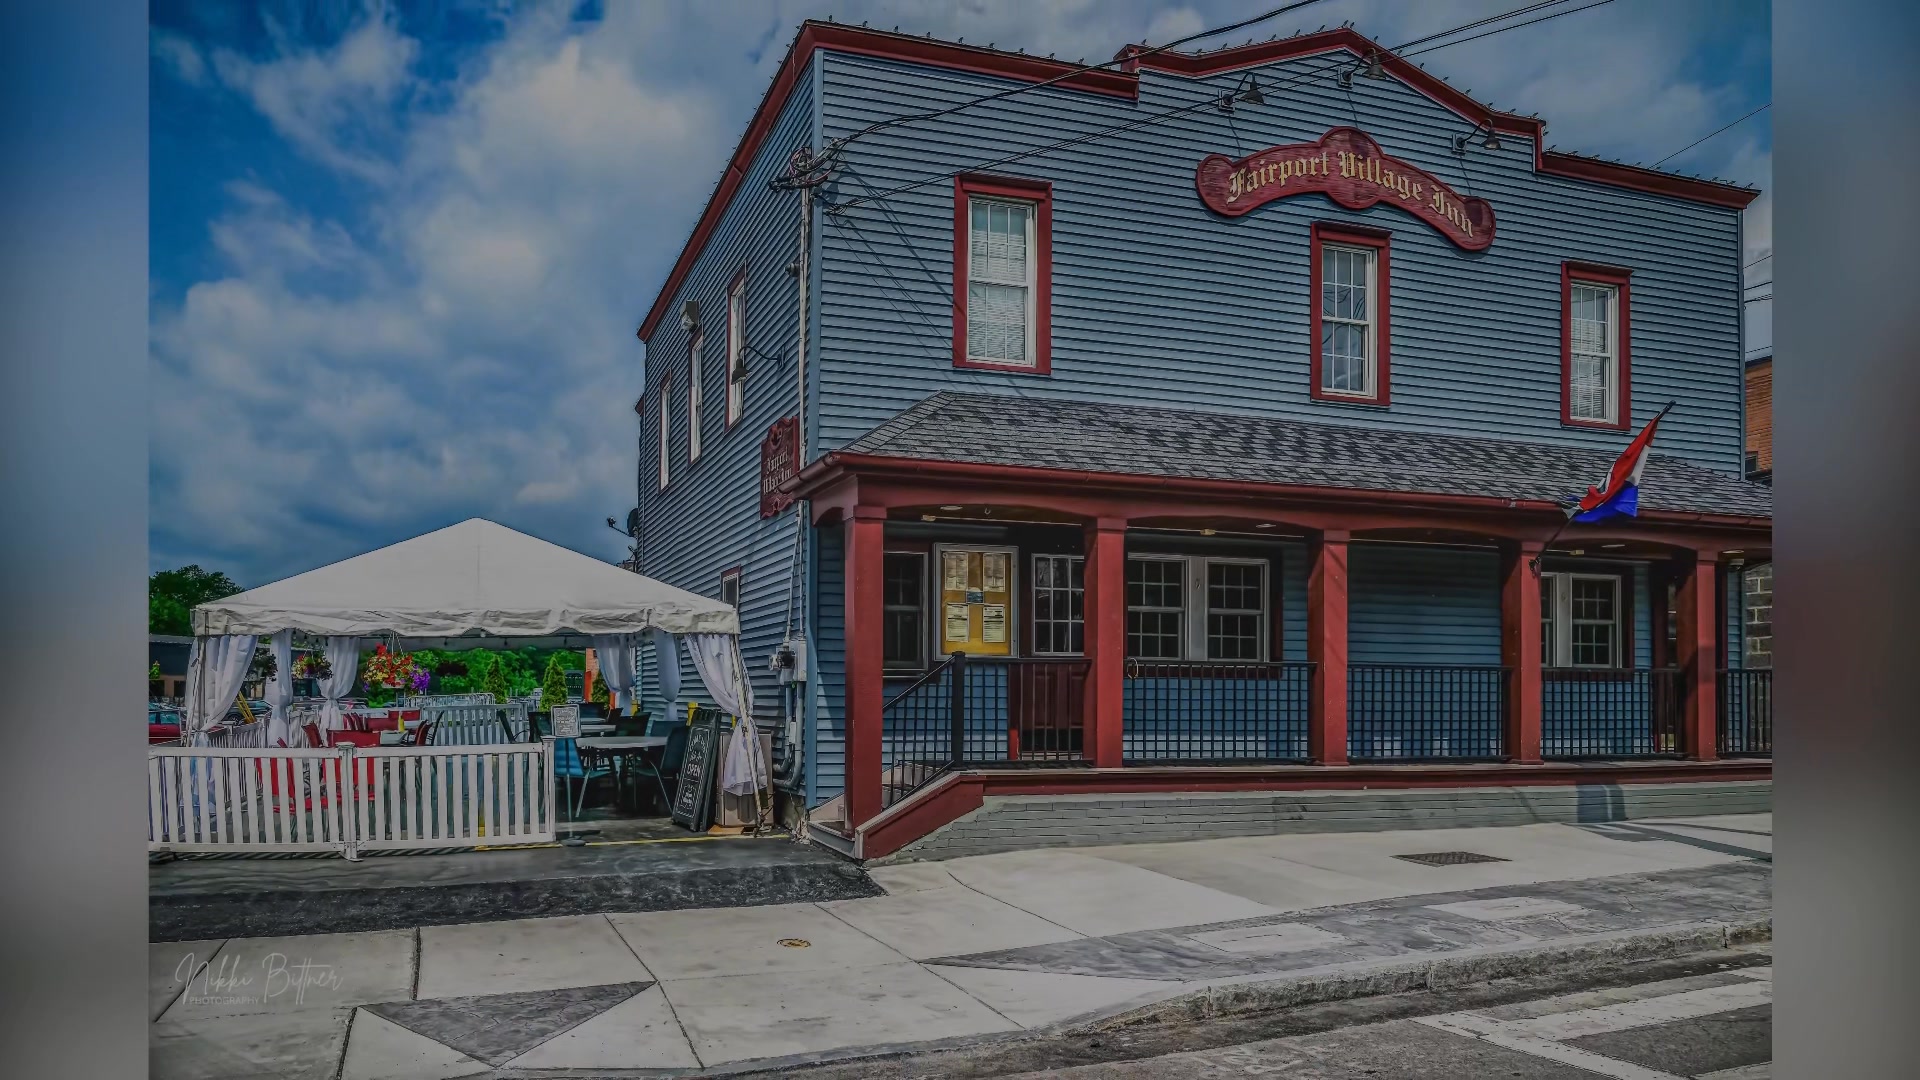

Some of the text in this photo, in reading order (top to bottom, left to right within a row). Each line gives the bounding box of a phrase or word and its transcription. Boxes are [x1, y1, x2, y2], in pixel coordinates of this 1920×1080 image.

[1226, 150, 1474, 238] Fairport Village Inn
